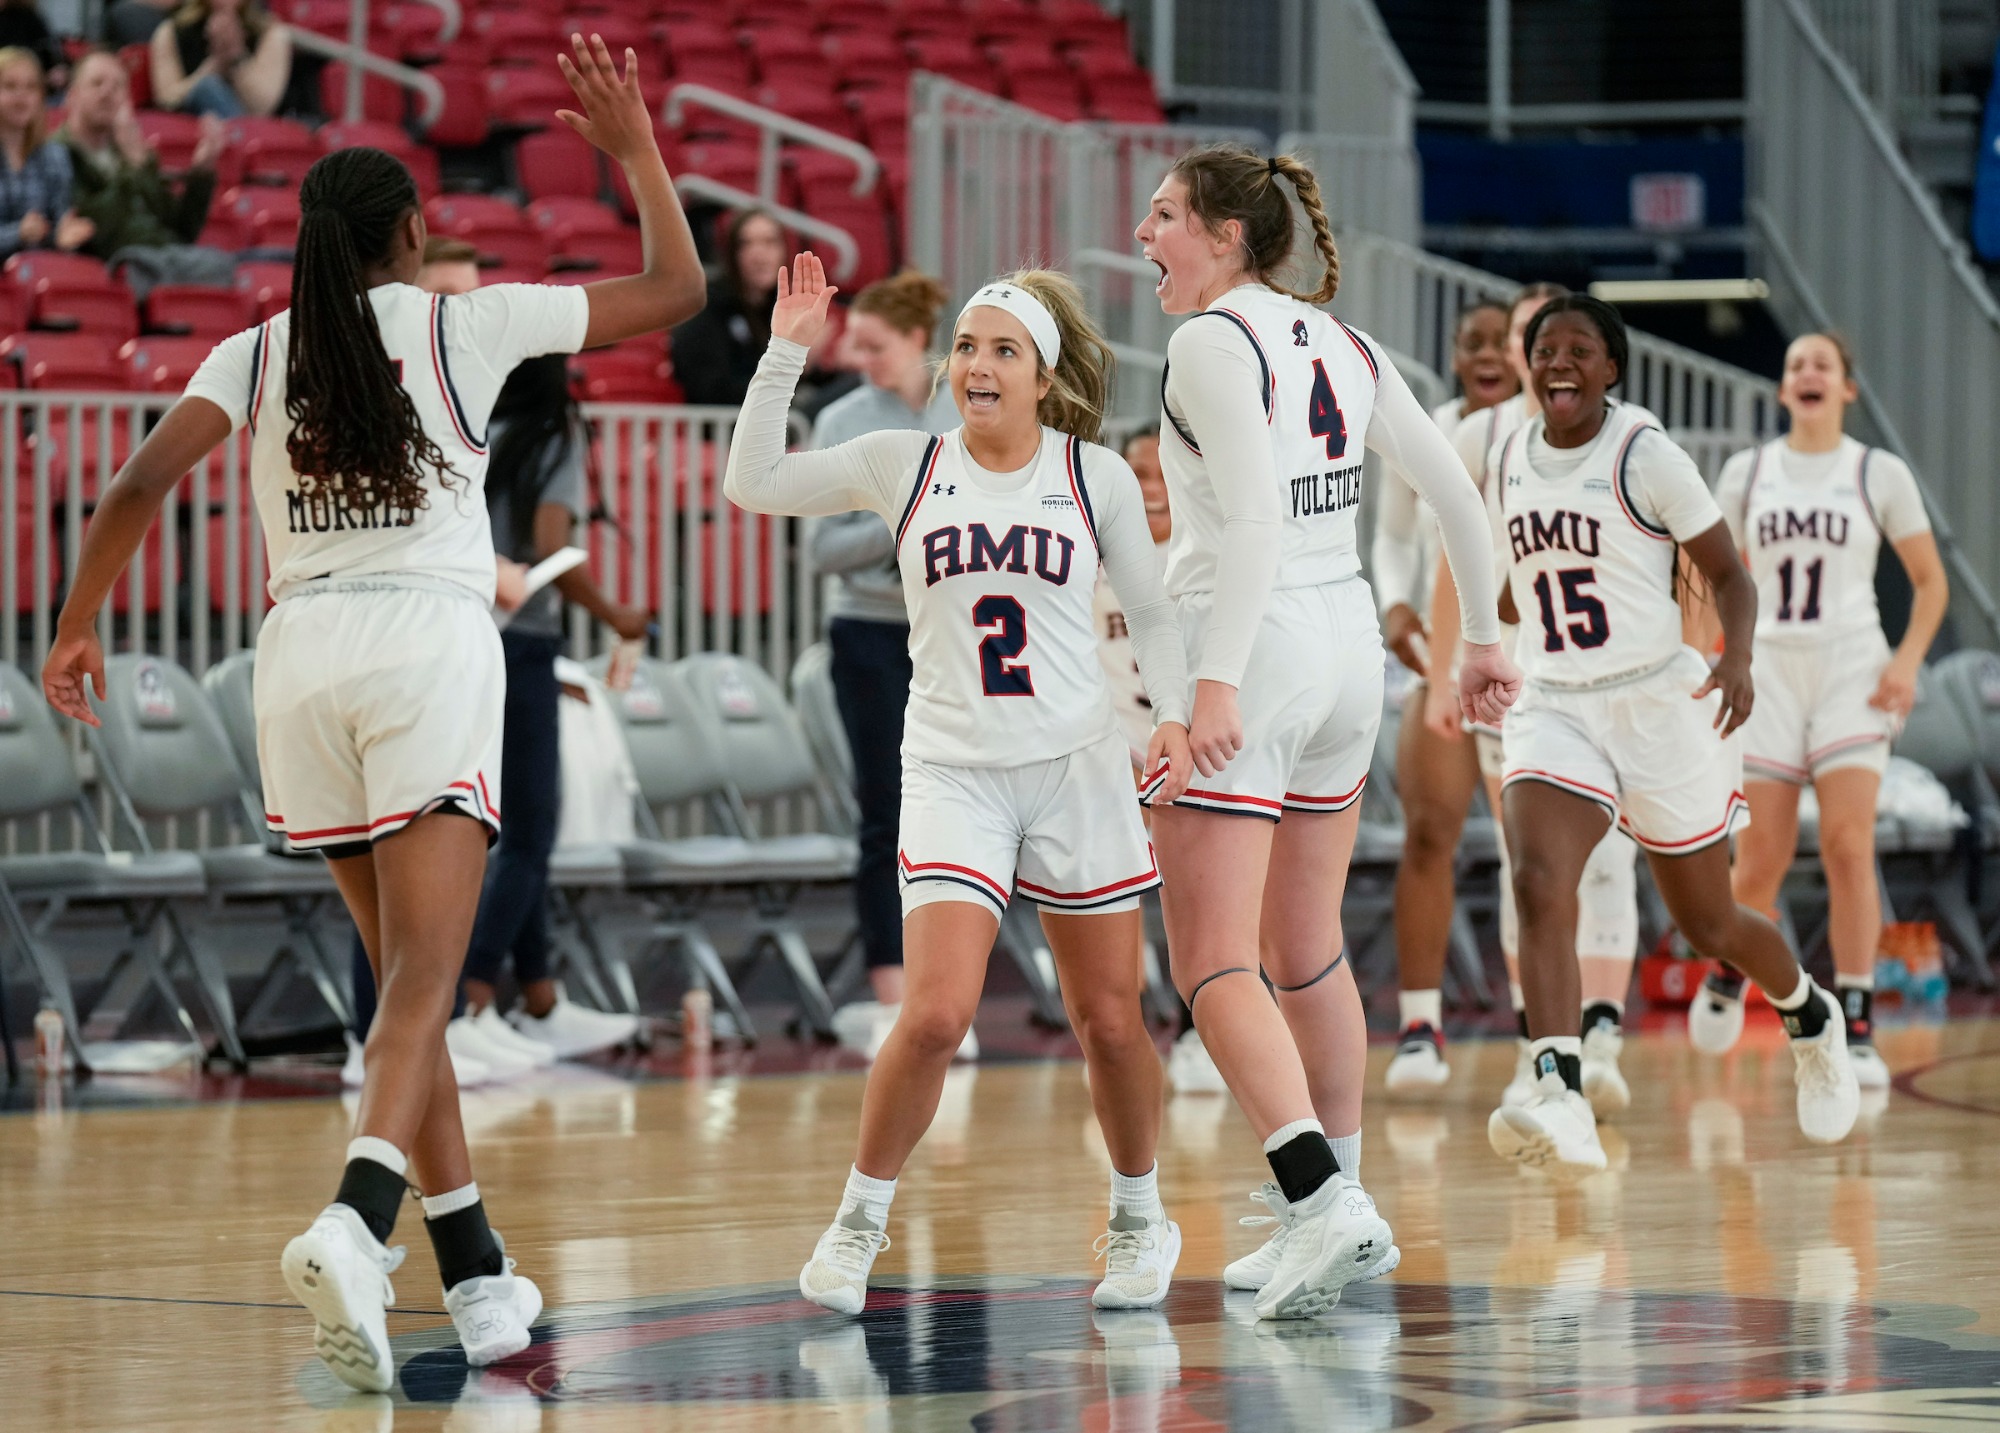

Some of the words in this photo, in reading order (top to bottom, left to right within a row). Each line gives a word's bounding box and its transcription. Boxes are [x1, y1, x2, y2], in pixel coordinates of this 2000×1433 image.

[1309, 358, 1347, 460] 4
[1291, 464, 1362, 518] VULETICH
[923, 523, 1075, 588] RMU
[1508, 509, 1601, 564] RMU
[1758, 507, 1849, 548] RMU
[1533, 567, 1610, 653] 15
[1776, 555, 1824, 622] 11
[972, 595, 1035, 696] 2
